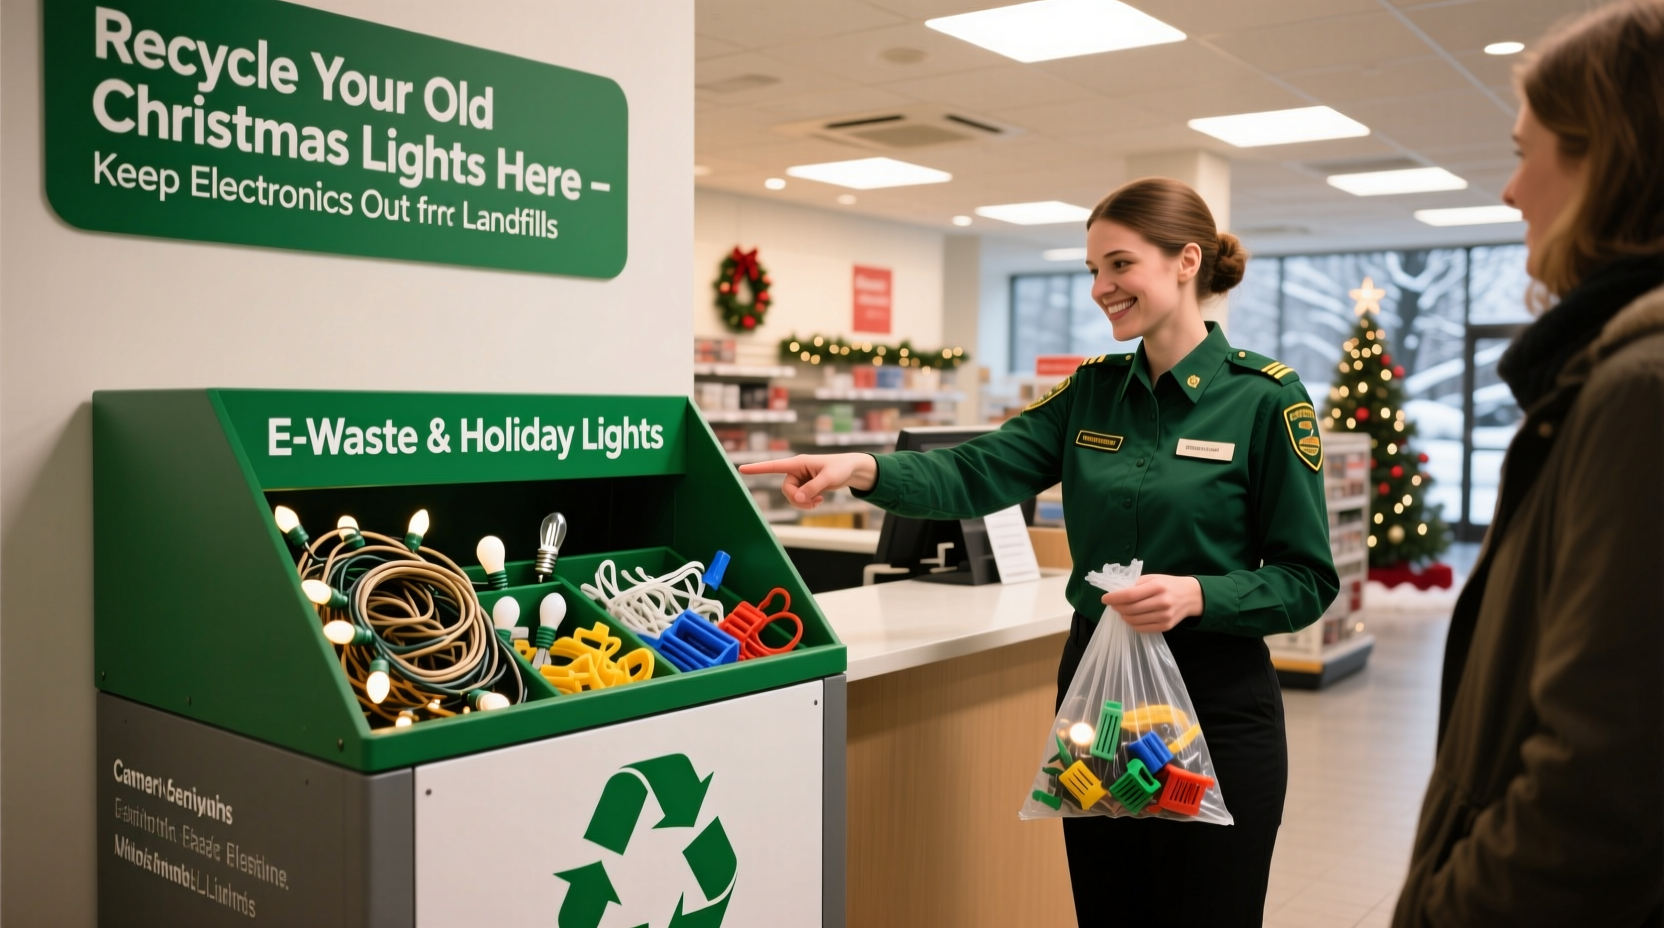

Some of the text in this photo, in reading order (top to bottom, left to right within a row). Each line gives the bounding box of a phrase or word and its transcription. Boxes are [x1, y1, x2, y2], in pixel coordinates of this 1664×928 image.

[96, 6, 494, 130] Recycle Your Old
[93, 78, 349, 166] Christmas
[363, 125, 486, 187] Lights
[497, 148, 582, 200] Here
[94, 151, 180, 202] Keep
[191, 165, 354, 216] Electronics
[361, 188, 411, 223] Out
[463, 200, 559, 240] Landfills
[268, 415, 664, 461] E-Waste & Holiday Lights
